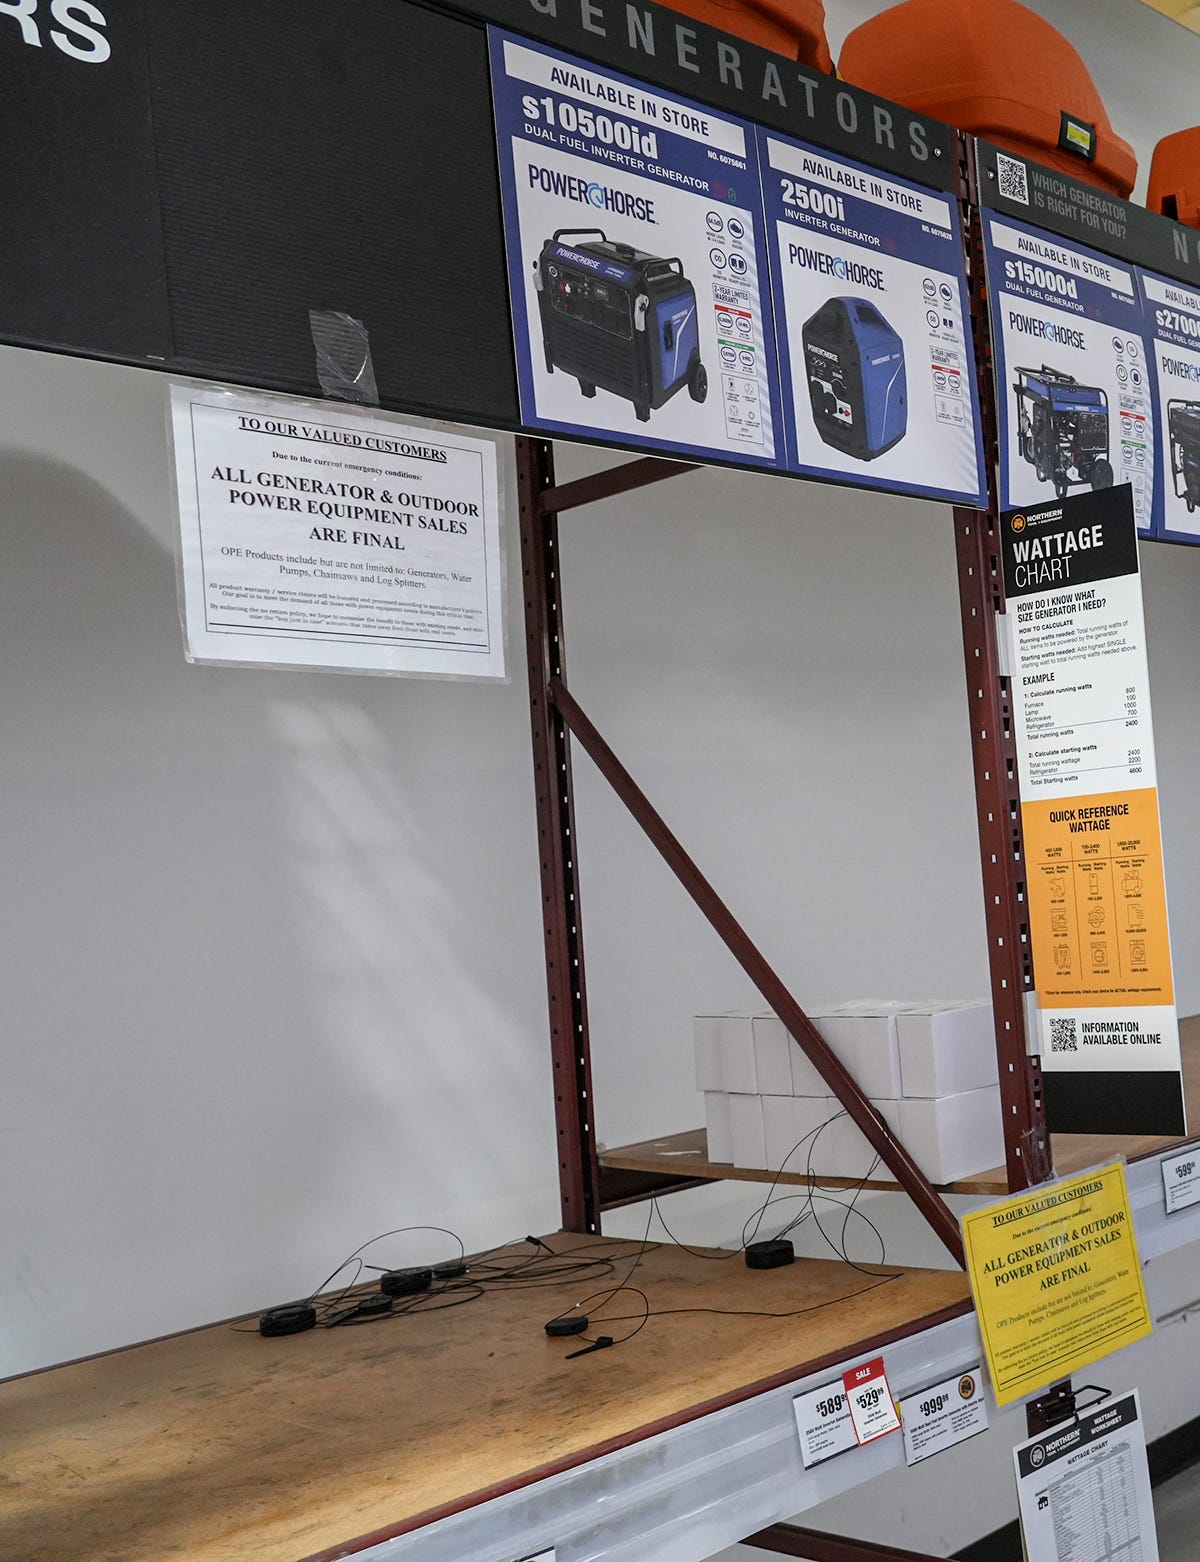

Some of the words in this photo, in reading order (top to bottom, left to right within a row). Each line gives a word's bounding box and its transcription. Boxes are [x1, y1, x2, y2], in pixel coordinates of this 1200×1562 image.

[550, 66, 636, 110] AVAILABLE
[642, 98, 657, 118] IN
[663, 106, 710, 137] STORE
[522, 95, 658, 159] s10500id
[524, 123, 557, 142] DUAL
[560, 134, 589, 152] FUEL
[591, 145, 645, 170] INVERTER
[648, 164, 710, 191] GENERATOR
[780, 178, 845, 222] 2500i
[802, 158, 866, 193] AVAILABLE
[870, 182, 882, 198] IN
[887, 188, 923, 213] STORE
[1032, 170, 1067, 198] WHICH
[1069, 187, 1127, 222] GENERATOR
[785, 207, 828, 230] INVERTER
[830, 223, 881, 247] GENERATOR
[1034, 191, 1045, 208] IS
[1048, 196, 1078, 221] RIGHT
[1081, 210, 1100, 230] FOR
[1102, 218, 1127, 240] YOU?
[1018, 237, 1068, 266] AVAILABLE
[1070, 256, 1080, 270] IN
[1083, 261, 1111, 282] STORE
[1005, 261, 1078, 299] s15000d
[1005, 281, 1025, 294] DUAL
[1026, 288, 1044, 300] FUEL
[1044, 293, 1085, 313] GENERATOR
[1174, 334, 1187, 345] FUEL
[238, 416, 260, 429] TO
[265, 421, 298, 436] OUR
[302, 427, 361, 446] VALUED
[366, 437, 447, 461] CUSTOMERS
[272, 451, 288, 460] Due
[314, 459, 342, 468] current
[345, 464, 383, 475] emergency
[385, 469, 422, 480] conditions:
[211, 466, 251, 484] ALL
[257, 472, 376, 501] GENERATOR
[380, 490, 393, 504] &
[398, 492, 479, 517] OUTDOOR
[229, 490, 302, 512] POWER
[307, 500, 414, 527] EQUIPMENT
[418, 515, 467, 534] SALES
[1026, 509, 1063, 522] NORTHERN
[310, 527, 347, 543] ARE
[353, 532, 405, 550] FINAL
[1013, 524, 1103, 564] WATTAGE
[221, 547, 242, 557] OPE
[246, 549, 283, 561] Products
[287, 554, 317, 565] include
[320, 557, 333, 567] but
[350, 562, 363, 570] not
[366, 562, 393, 573] limited
[407, 568, 448, 580] Generators,
[451, 573, 472, 583] Water
[280, 566, 311, 578] Pumps,
[314, 569, 358, 581] Chainsaws
[360, 575, 374, 583] and
[377, 576, 392, 586] Log
[1015, 555, 1072, 588] CHART
[1017, 601, 1033, 613] HOW
[1035, 599, 1045, 609] DO
[1051, 594, 1073, 605] KNOW
[1074, 589, 1095, 601] WHAT
[1018, 611, 1033, 623] SIZE
[1035, 603, 1077, 620] GENERATOR
[1083, 598, 1106, 611] NEED?
[1019, 626, 1031, 634] HOW
[1033, 624, 1040, 632] TO
[1042, 619, 1073, 631] CALCULATE
[1022, 672, 1055, 685] EXAMPLE
[1030, 689, 1054, 698] Calculate
[1056, 685, 1076, 694] running
[1034, 749, 1059, 758] Calculate
[1050, 810, 1076, 823] QUICK
[1078, 803, 1129, 819] REFERENCE
[1069, 819, 1111, 834] WATTAGE
[1081, 1021, 1139, 1034] INFORMATION
[1083, 1033, 1128, 1046] AVAILABLE
[1130, 1033, 1162, 1045] ONLINE
[992, 1215, 1005, 1225] TO
[1006, 1208, 1024, 1221] OUR
[1025, 1196, 1057, 1213] VALUED
[1058, 1180, 1103, 1202] CUSTOMERS
[984, 1257, 1006, 1274] ALL
[1007, 1232, 1069, 1265] GENERATOR
[1071, 1229, 1079, 1241] &
[1081, 1211, 1125, 1237] OUTDOOR
[994, 1263, 1033, 1287] POWER
[1036, 1239, 1092, 1272] EQUIPMENT
[1095, 1228, 1121, 1249] SALES
[1040, 1273, 1060, 1291] ARE
[1062, 1262, 1091, 1282] FINAL
[855, 1368, 871, 1380] SALE
[1091, 1415, 1122, 1435] WORKSHEET
[1094, 1409, 1117, 1424] WATTAGE
[1046, 1429, 1081, 1452] NORTHERN
[1067, 1449, 1090, 1465] WATTAGE
[1091, 1440, 1108, 1453] CHART
